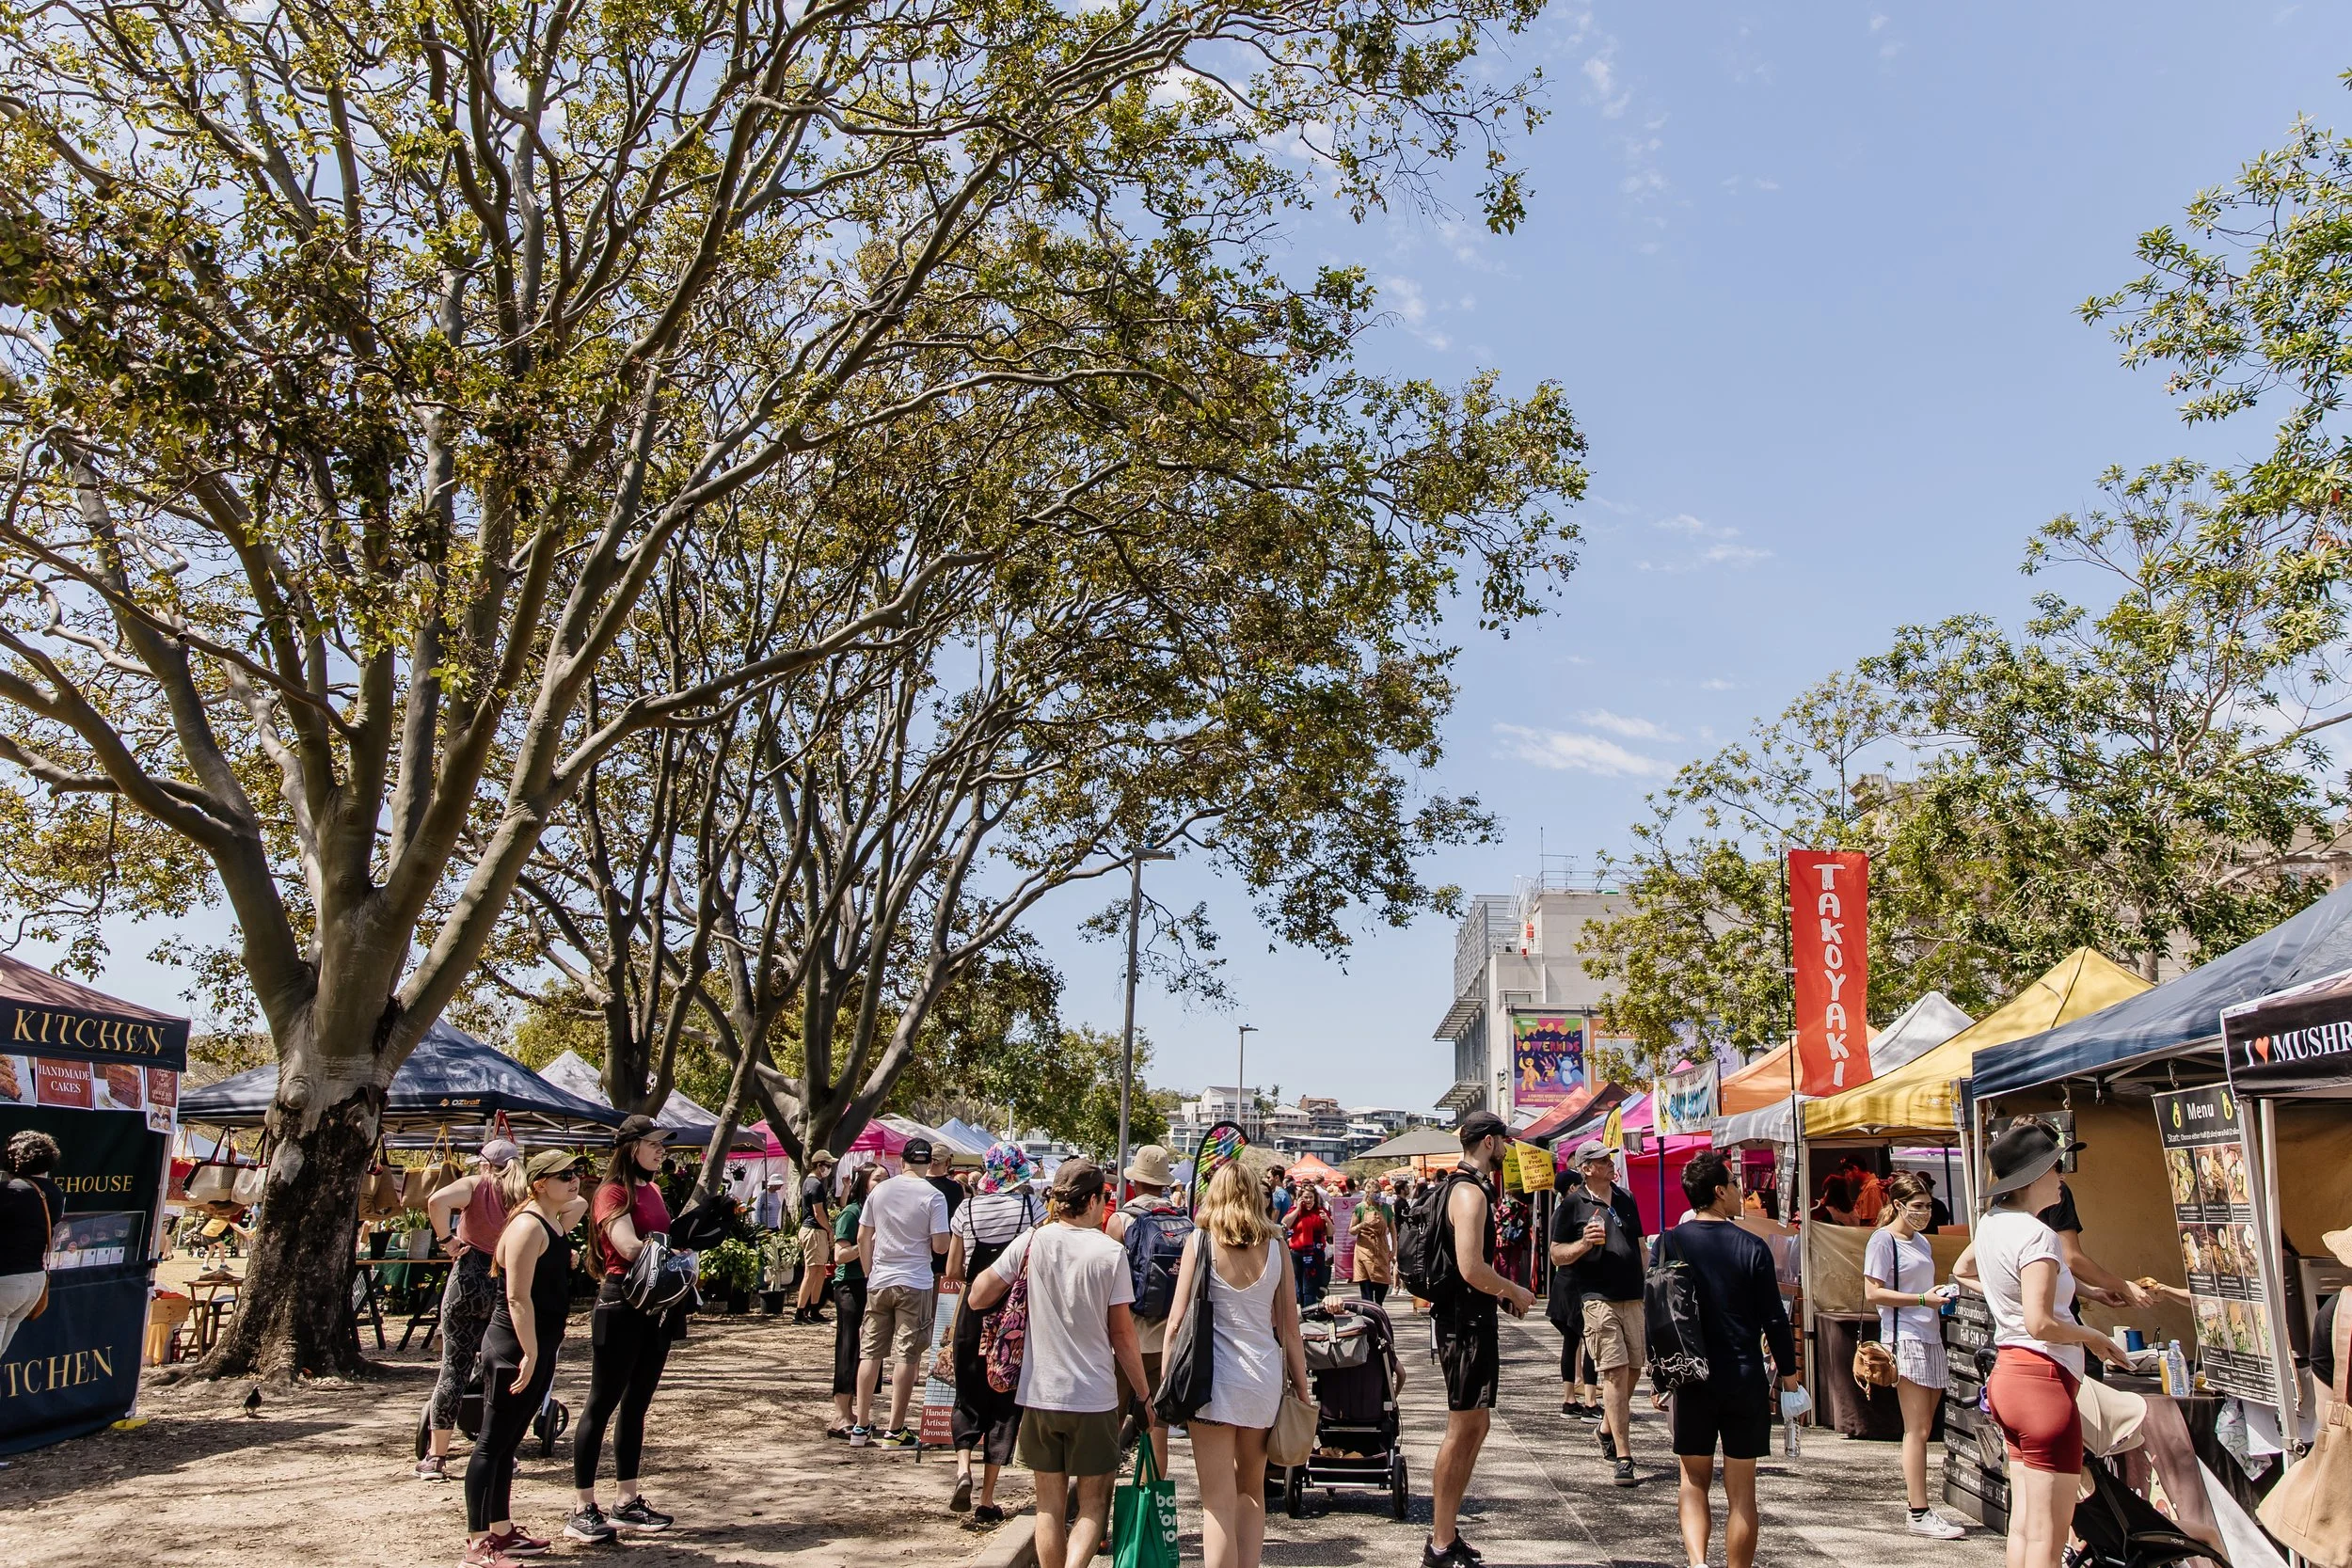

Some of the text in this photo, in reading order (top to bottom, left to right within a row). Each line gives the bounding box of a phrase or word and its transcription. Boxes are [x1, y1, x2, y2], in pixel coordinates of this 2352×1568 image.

[1812, 863, 1850, 1087] TAKOYAKI
[11, 1007, 166, 1056] KITCHEN
[1517, 1040, 1581, 1052] POWERKIDS
[2244, 1021, 2352, 1068] I MUSHR
[39, 1064, 90, 1082] HANDMADE
[50, 1081, 82, 1094] CAKES
[2186, 1102, 2215, 1120] Menu
[1963, 1306, 1989, 1323] sourdough
[1960, 1328, 1969, 1342] Full
[0, 1346, 113, 1399] TCHEN
[924, 1418, 949, 1427] Artisan
[1946, 1409, 1956, 1422] Deals
[923, 1428, 952, 1437] Brownie
[1960, 1441, 1968, 1455] with
[1968, 1445, 1980, 1461] bacon
[1950, 1465, 1959, 1481] Half
[1959, 1469, 1968, 1484] with
[1968, 1474, 1980, 1490] bacon
